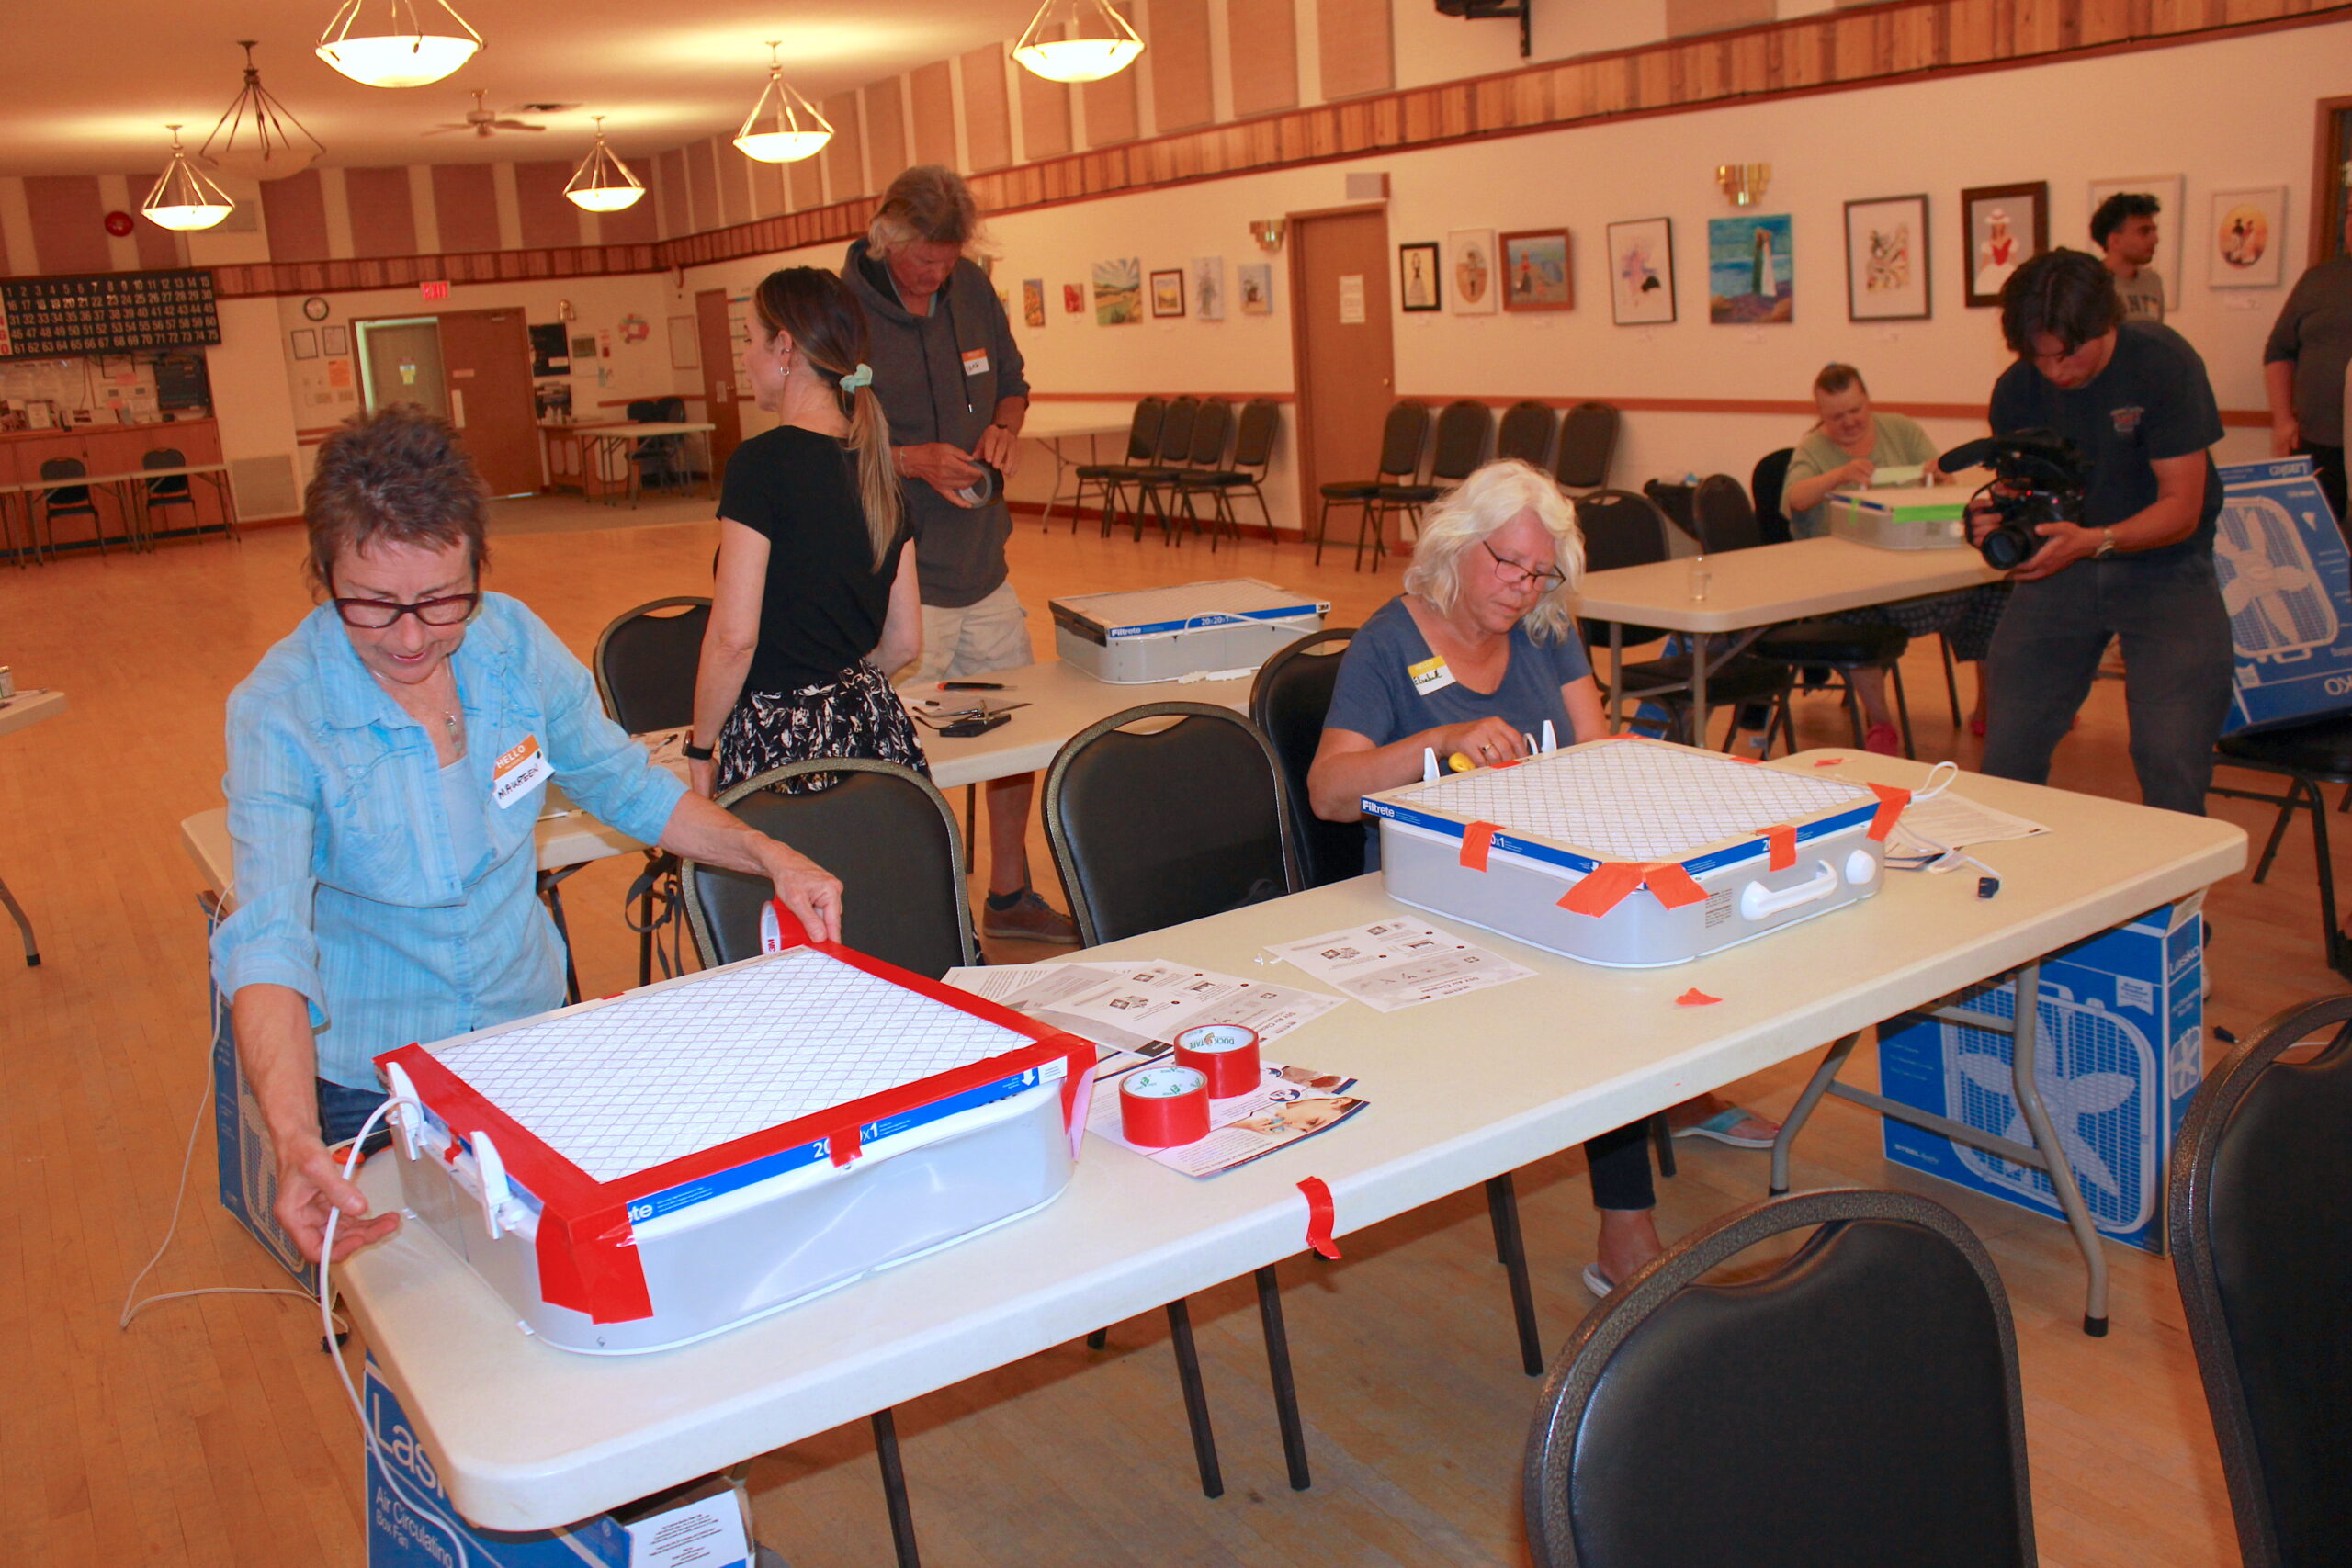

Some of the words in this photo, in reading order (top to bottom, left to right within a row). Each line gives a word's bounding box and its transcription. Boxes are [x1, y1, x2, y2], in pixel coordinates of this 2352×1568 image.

[7, 288, 13, 298] 1
[20, 287, 28, 296] 2
[35, 285, 41, 296] 3
[50, 285, 55, 294] 4
[62, 284, 70, 294] 5
[77, 283, 85, 294] 6
[91, 281, 98, 292] 7
[107, 281, 114, 292] 8
[121, 280, 128, 292] 9
[134, 279, 143, 290] 10
[148, 279, 156, 290] 11
[161, 279, 169, 289] 12
[175, 278, 184, 288] 13
[187, 277, 197, 287] 14
[200, 276, 209, 287] 15
[422, 281, 448, 299] EXIT
[7, 301, 17, 311] 16
[21, 299, 30, 310] 17
[37, 299, 46, 310] 18
[51, 298, 61, 309] 19
[62, 298, 74, 309] 20
[77, 298, 88, 308] 21
[92, 296, 103, 307] 22
[107, 295, 118, 306] 23
[121, 295, 132, 305] 24
[134, 294, 146, 304] 25
[147, 293, 160, 304] 26
[162, 292, 172, 302] 27
[175, 291, 186, 301] 28
[188, 291, 198, 301] 29
[202, 290, 213, 299] 30
[9, 314, 20, 325] 31
[23, 314, 35, 325] 32
[37, 313, 50, 323] 33
[51, 312, 62, 323] 34
[66, 312, 77, 322] 35
[80, 311, 92, 321] 36
[94, 310, 104, 321] 37
[109, 309, 121, 320] 38
[123, 309, 134, 318] 39
[137, 307, 148, 318] 40
[151, 307, 162, 317] 41
[164, 305, 175, 316] 42
[177, 304, 188, 315] 43
[190, 304, 200, 314] 44
[204, 303, 215, 313] 45
[11, 329, 23, 340] 46
[26, 328, 37, 338] 47
[40, 327, 51, 338] 48
[55, 327, 65, 336] 49
[68, 325, 80, 336] 50
[83, 325, 92, 335] 51
[96, 323, 107, 334] 52
[111, 322, 123, 333] 53
[125, 321, 136, 332] 54
[139, 321, 151, 331] 55
[153, 320, 164, 331] 56
[165, 318, 176, 329] 57
[178, 318, 190, 329] 58
[192, 317, 202, 327] 59
[205, 316, 217, 327] 60
[14, 344, 25, 353] 61
[28, 342, 39, 353] 62
[42, 342, 53, 352] 63
[56, 340, 68, 351] 64
[70, 340, 83, 351] 65
[85, 338, 96, 349] 66
[97, 338, 108, 348] 67
[114, 336, 125, 347] 68
[127, 334, 139, 345] 69
[141, 334, 153, 344] 70
[154, 334, 165, 344] 71
[167, 333, 178, 344] 72
[181, 331, 191, 342] 73
[195, 331, 204, 340] 74
[208, 329, 219, 340] 75
[1317, 603, 1329, 612] 3M
[1111, 626, 1141, 637] Filtrete
[496, 745, 526, 768] HELLO
[1362, 799, 1395, 818] Filtrete
[767, 939, 776, 952] 3M
[2170, 945, 2199, 976] Lasko
[1214, 1037, 1235, 1045] DUCK
[375, 1486, 391, 1514] Air
[393, 1502, 454, 1568] Circulating
[376, 1509, 391, 1536] Box
[393, 1529, 409, 1550] Fan
